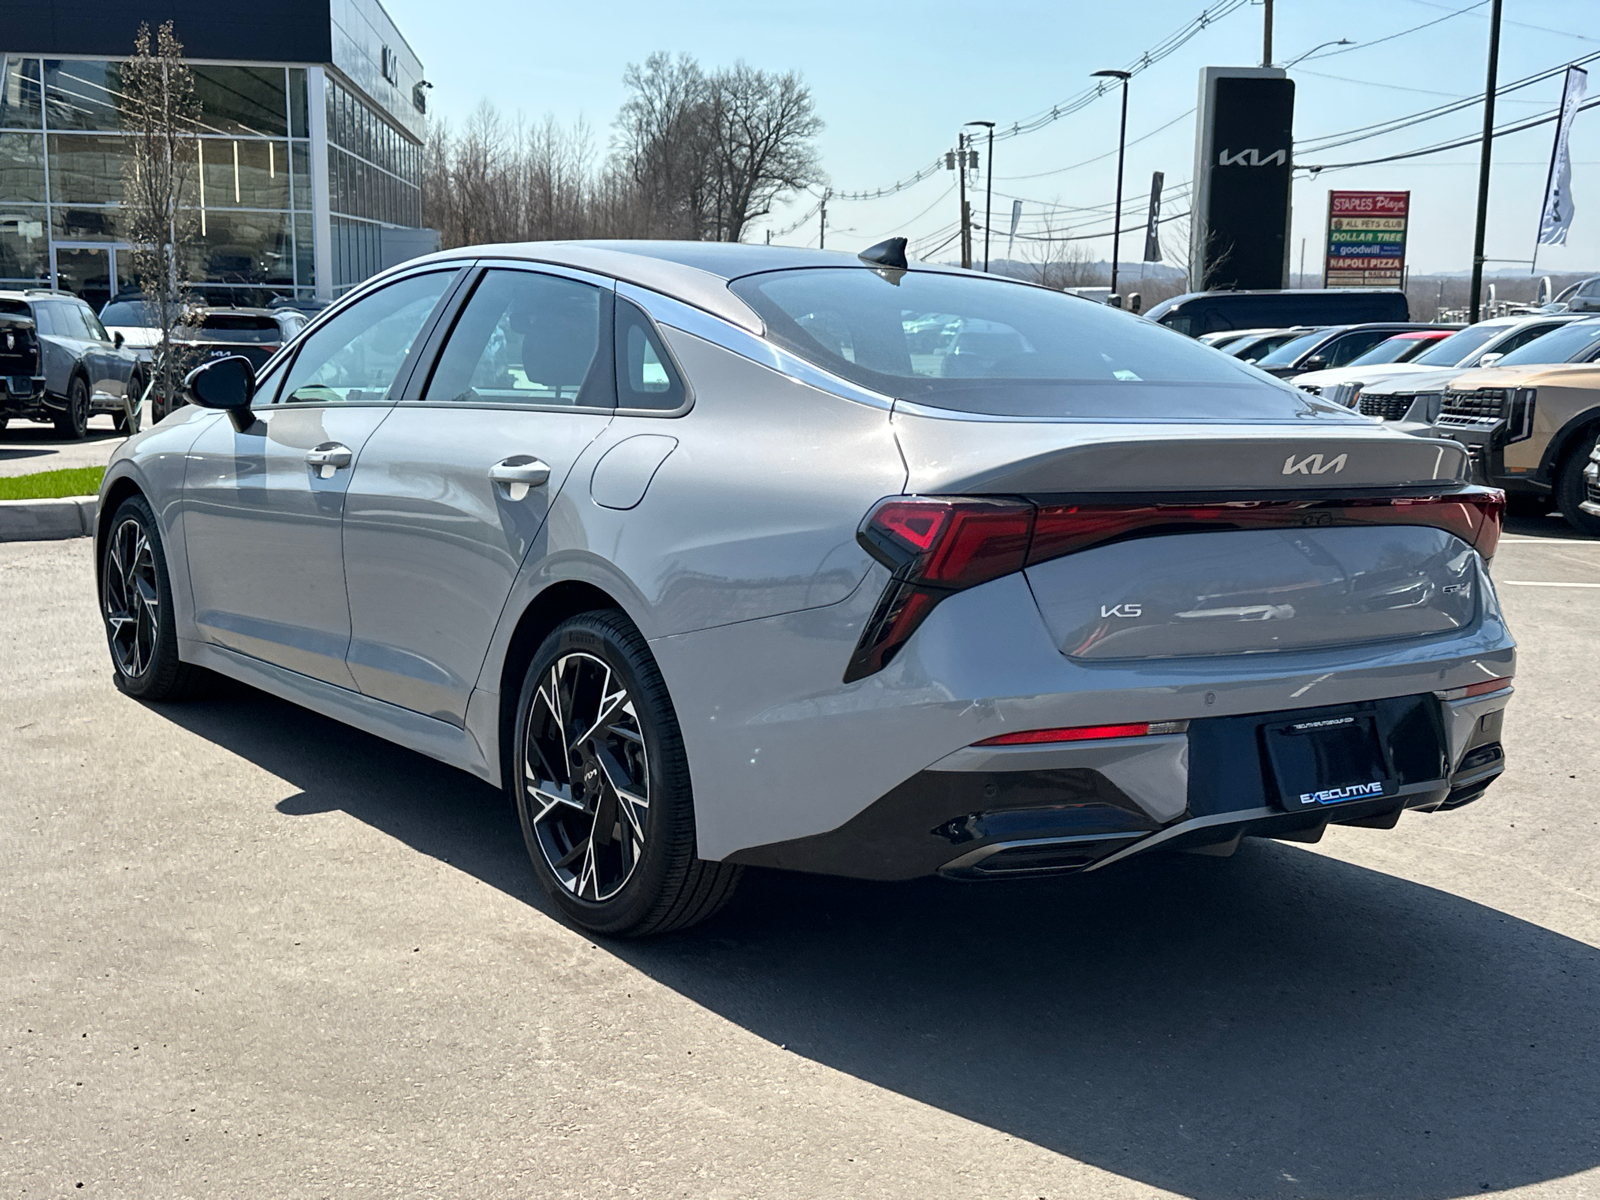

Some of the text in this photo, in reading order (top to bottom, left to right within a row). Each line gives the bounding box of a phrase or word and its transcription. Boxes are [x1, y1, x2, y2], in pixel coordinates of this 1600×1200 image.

[1219, 148, 1286, 166] KIA
[1333, 196, 1405, 211] STAPLES Plaza
[1345, 220, 1402, 228] ALL PETS CLUB
[1332, 232, 1402, 241] DOLLAR TREE
[1340, 244, 1380, 256] goodwill
[1330, 258, 1400, 268] NAPOLI PIZZA
[1282, 453, 1348, 475] KIA
[1101, 603, 1142, 618] K5
[1299, 781, 1383, 805] EXECUTIVE
